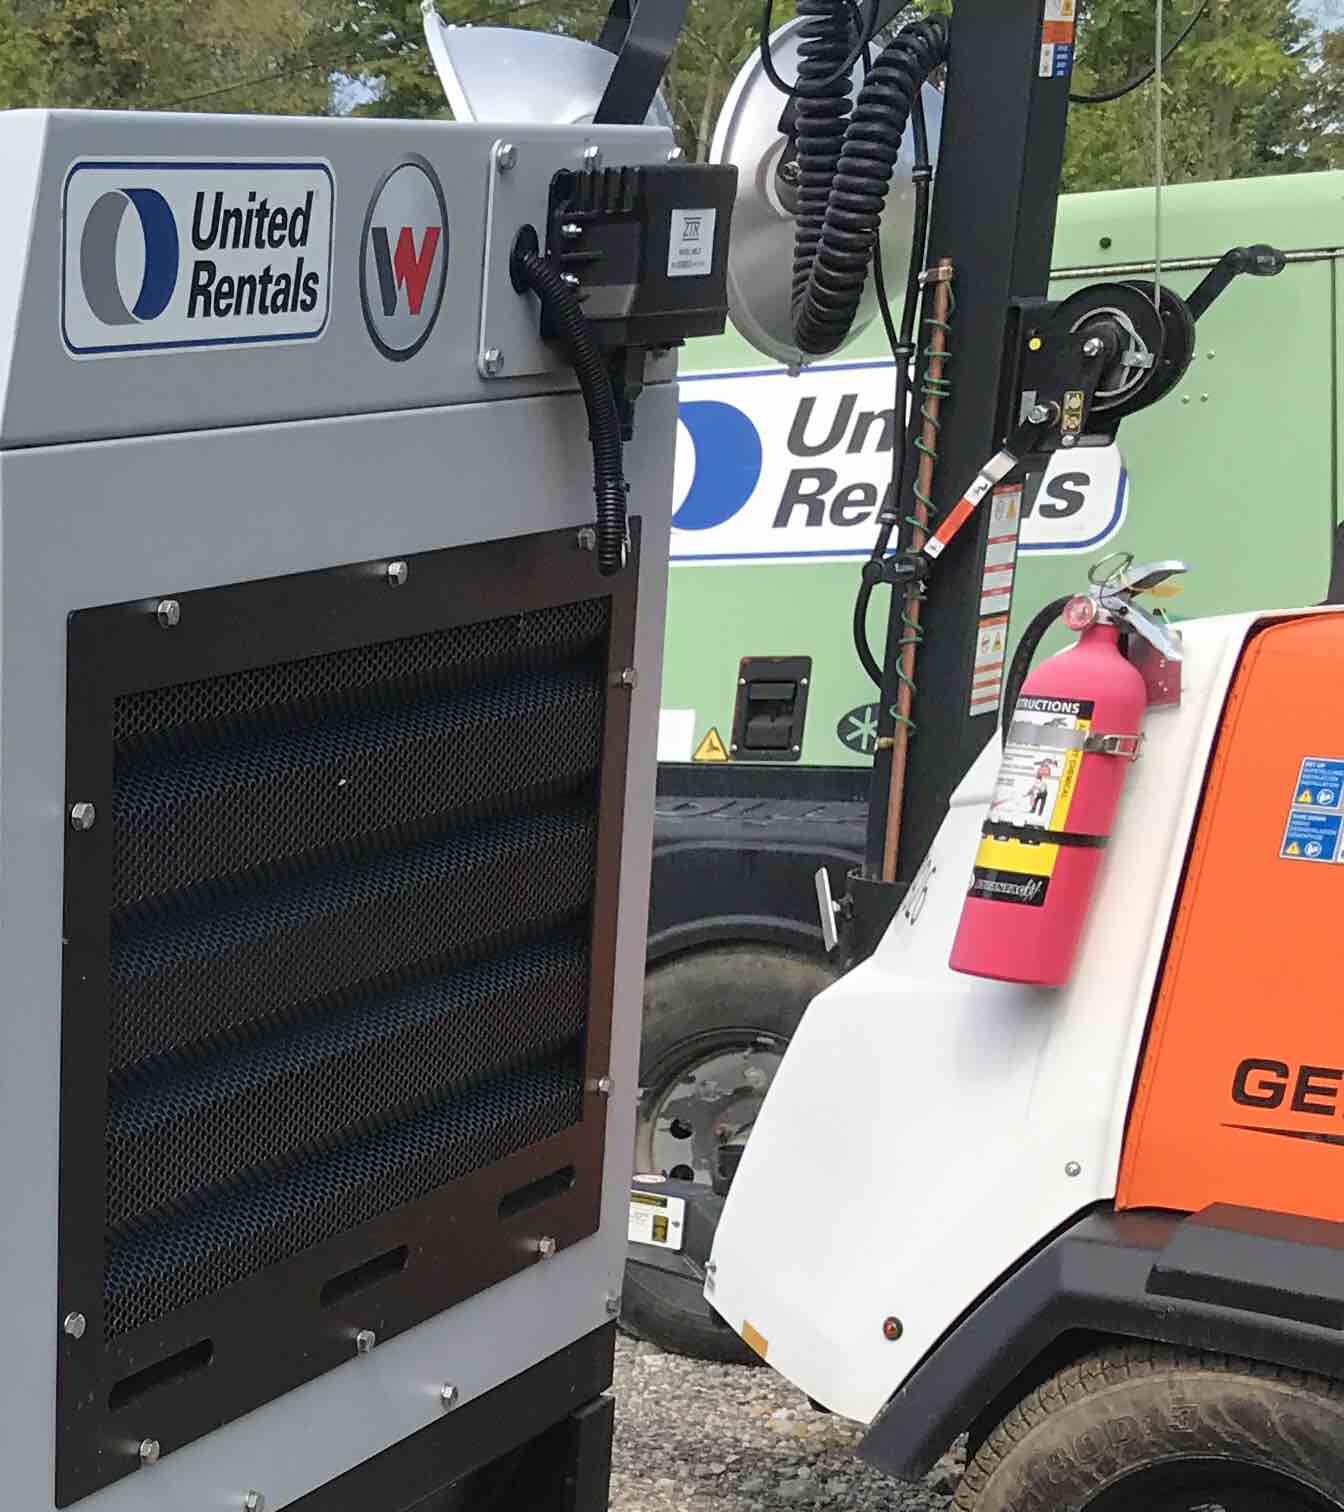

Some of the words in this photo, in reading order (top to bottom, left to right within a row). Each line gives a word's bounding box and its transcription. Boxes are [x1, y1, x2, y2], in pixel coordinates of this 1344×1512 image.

[190, 190, 314, 251] United
[186, 257, 320, 319] Rentals
[370, 225, 442, 317] W
[1017, 698, 1081, 714] RUCTIONS
[1231, 1057, 1344, 1118] GE
